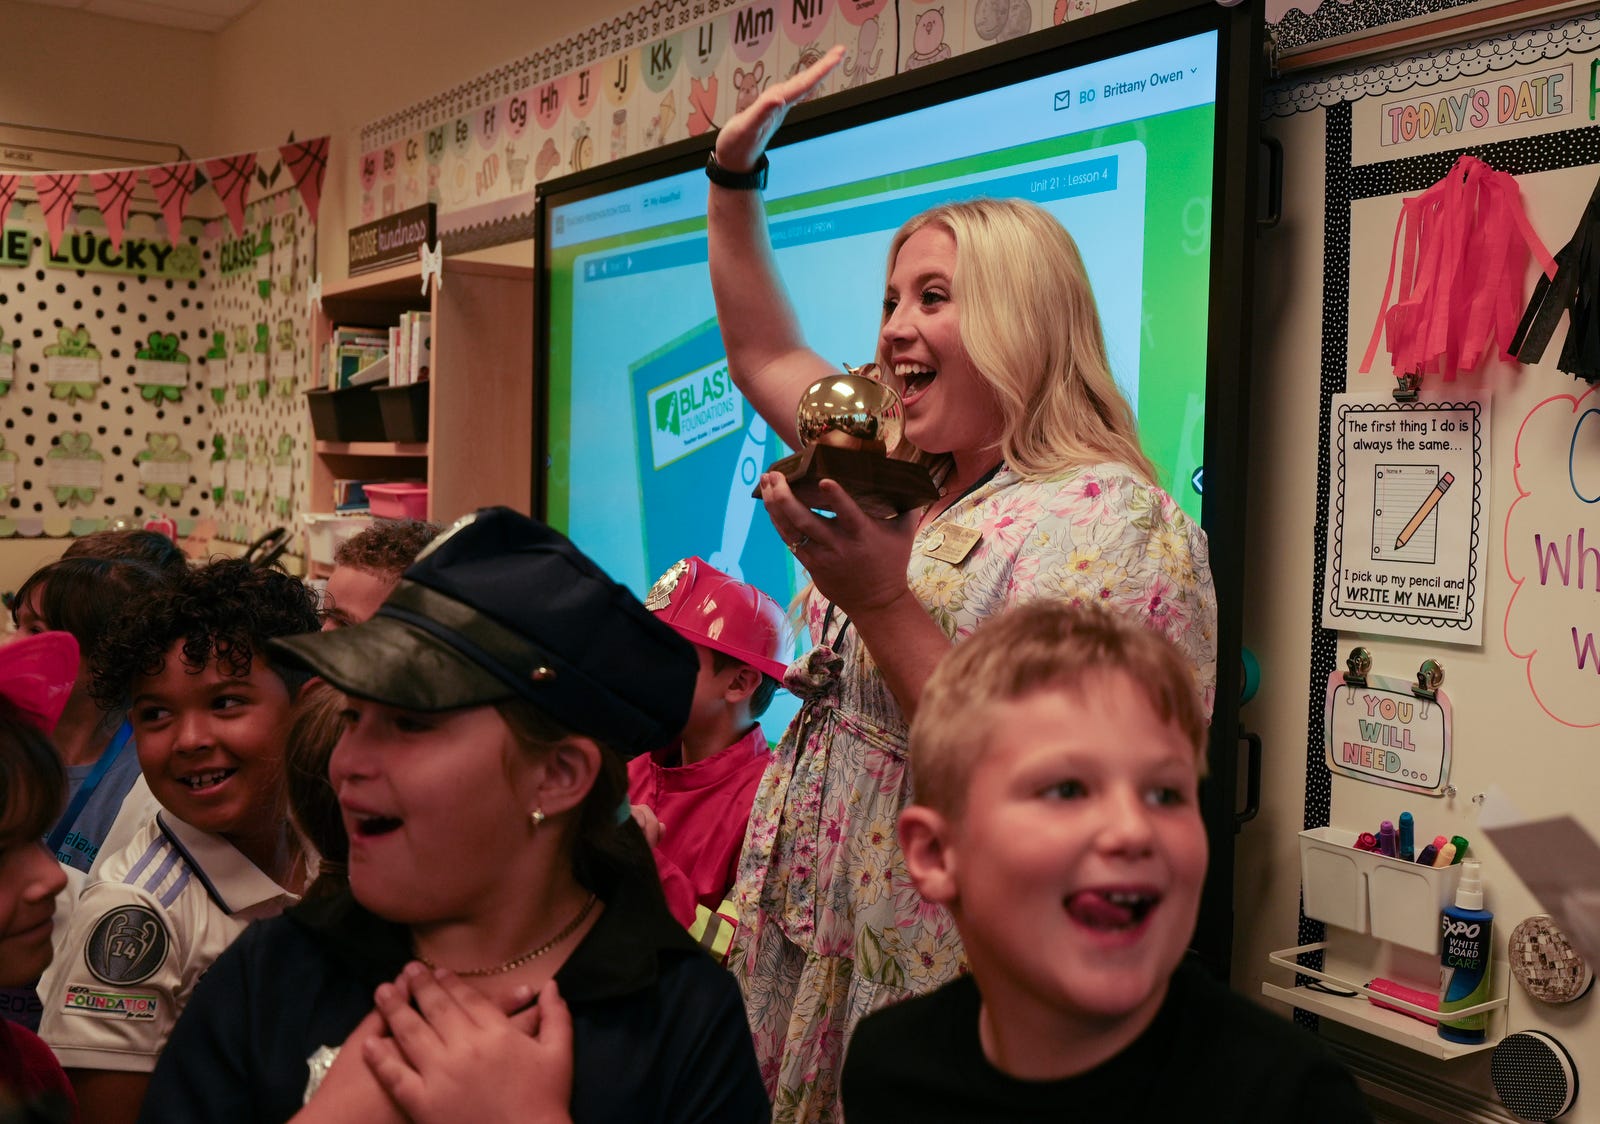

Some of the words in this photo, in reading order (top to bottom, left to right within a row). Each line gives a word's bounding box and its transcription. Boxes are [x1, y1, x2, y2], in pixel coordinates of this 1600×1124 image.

[599, 42, 609, 57] 27
[611, 37, 621, 53] 28
[624, 32, 634, 47] 29
[637, 26, 648, 42] 30
[652, 22, 660, 36] 31
[664, 15, 675, 31] 32
[678, 9, 690, 25] 33
[693, 3, 705, 19] 34
[708, 0, 719, 13] 35
[734, 7, 774, 44] Mm
[650, 40, 672, 75] Kk
[578, 69, 590, 100] Ii
[614, 55, 629, 93] Jj
[1079, 88, 1096, 104] BO
[1103, 79, 1147, 98] Brittany
[1150, 70, 1184, 87] Owen
[509, 97, 527, 127] Gg
[540, 82, 559, 114] Hh
[1388, 88, 1490, 144] TODAY'S
[1498, 73, 1564, 125] DATE
[455, 119, 468, 143] Ee
[483, 105, 496, 134] Ff
[405, 139, 417, 161] Cc
[429, 125, 444, 154] Dd
[1030, 180, 1048, 193] Unit
[1050, 177, 1060, 190] 21
[1068, 171, 1099, 186] Lesson
[1101, 168, 1108, 179] 4
[0, 230, 28, 261] E
[377, 219, 426, 251] kindness
[680, 366, 732, 416] BLAST
[681, 397, 735, 432] FOUNDATIONS
[1348, 420, 1368, 432] The
[1371, 420, 1396, 432] first
[1400, 420, 1427, 435] thing
[1431, 419, 1437, 431] I
[1440, 419, 1455, 431] do
[1459, 419, 1469, 431] is
[1353, 439, 1393, 454] always
[1397, 438, 1415, 451] the
[1418, 440, 1462, 451] same...
[1344, 569, 1349, 580] I
[1352, 570, 1372, 583] pick
[1375, 573, 1388, 586] up
[1391, 575, 1406, 588] my
[1409, 576, 1441, 589] pencil
[1443, 578, 1465, 590] and
[1346, 586, 1389, 603] WRITE
[1394, 590, 1412, 606] MY
[1417, 592, 1461, 610] NAME!
[1363, 694, 1414, 724] YOU
[1358, 719, 1416, 752] WILL
[1343, 742, 1428, 782] NEED...
[1442, 915, 1481, 939] EXPO
[111, 940, 137, 960] 14
[1448, 946, 1479, 958] BOARD
[1449, 938, 1479, 951] WHITE
[1447, 955, 1480, 970] CARE
[65, 994, 157, 1011] FOUNDATION
